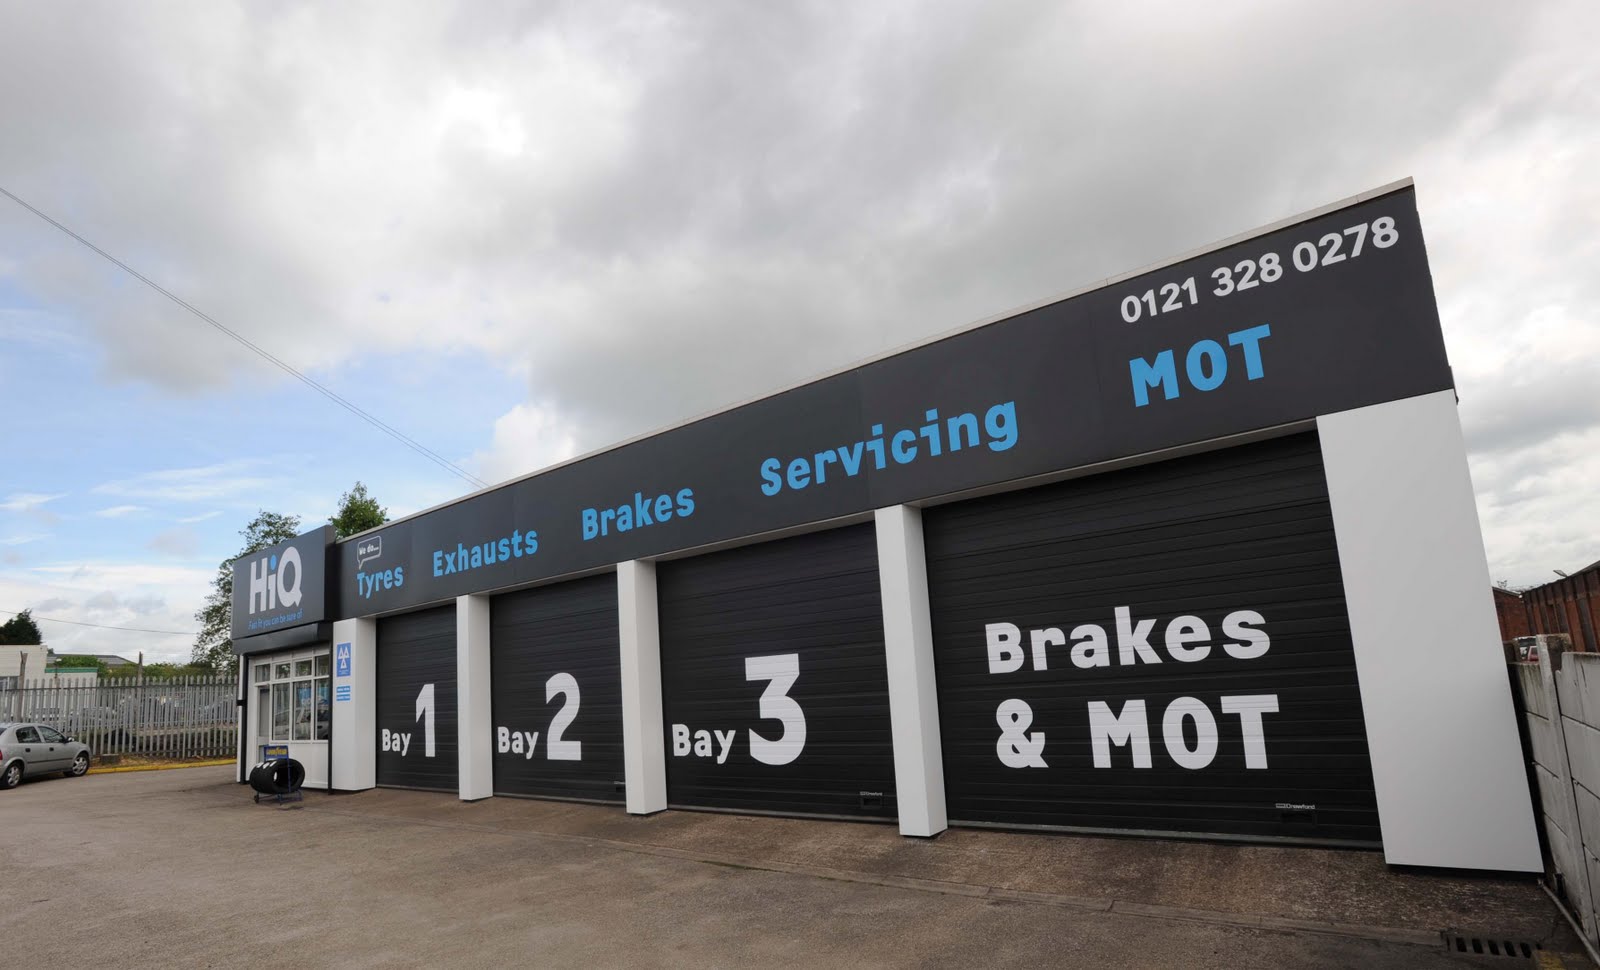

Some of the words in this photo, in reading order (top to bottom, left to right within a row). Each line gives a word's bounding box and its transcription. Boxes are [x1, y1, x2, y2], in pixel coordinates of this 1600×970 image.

[1121, 277, 1198, 323] 0121
[1211, 252, 1283, 297] 328
[1292, 216, 1399, 272] 0278
[1130, 324, 1270, 407] MOT
[760, 401, 1018, 497] Servicing
[582, 488, 695, 541] Brakes
[249, 546, 302, 615] HiQ
[357, 566, 404, 599] Tyres
[432, 529, 538, 577] Exhausts
[985, 606, 1270, 674] Brakes
[381, 728, 411, 757] Bay
[416, 684, 436, 758] 1
[497, 726, 538, 760] Bay
[545, 673, 581, 761] 2
[672, 723, 736, 765] Bay
[745, 654, 807, 766] 3
[995, 699, 1048, 768] &
[1088, 695, 1280, 770] MOT
